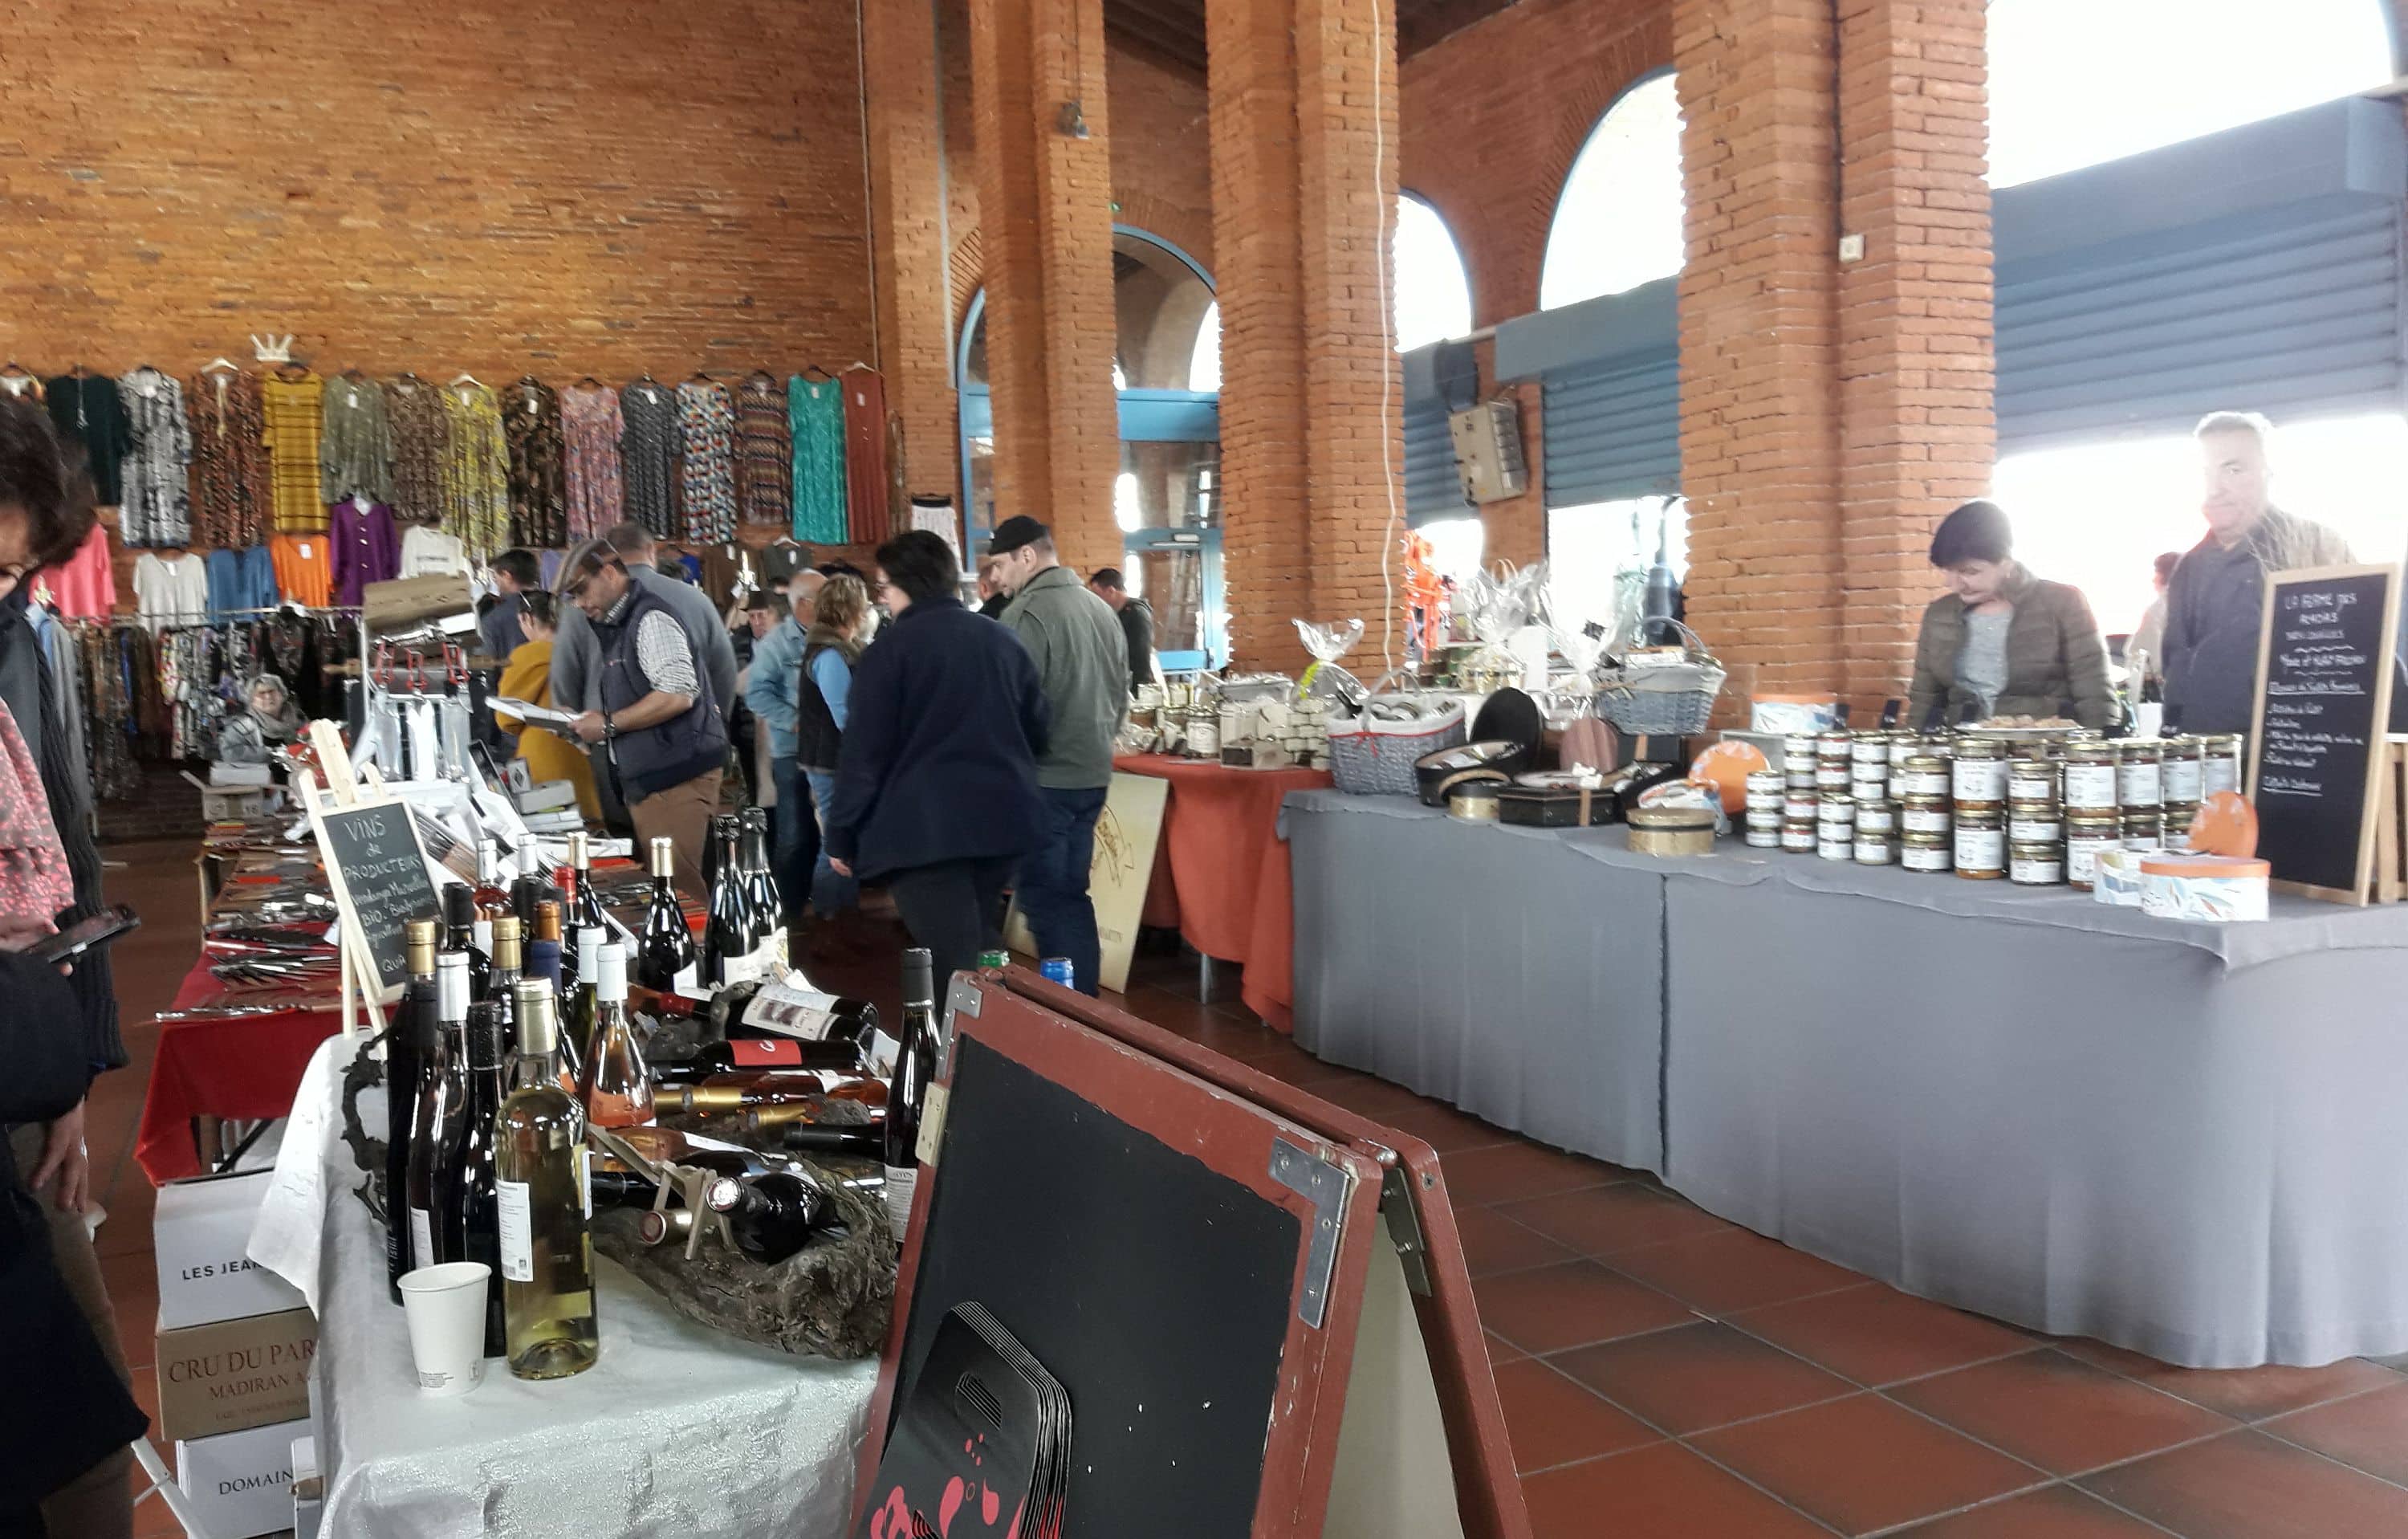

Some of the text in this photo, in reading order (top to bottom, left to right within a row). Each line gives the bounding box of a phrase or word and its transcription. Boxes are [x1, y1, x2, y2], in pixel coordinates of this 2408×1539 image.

[182, 1265, 214, 1280] LES
[168, 1354, 220, 1382] CRU
[229, 1346, 262, 1372] DU
[209, 1373, 289, 1399] MADIRAN
